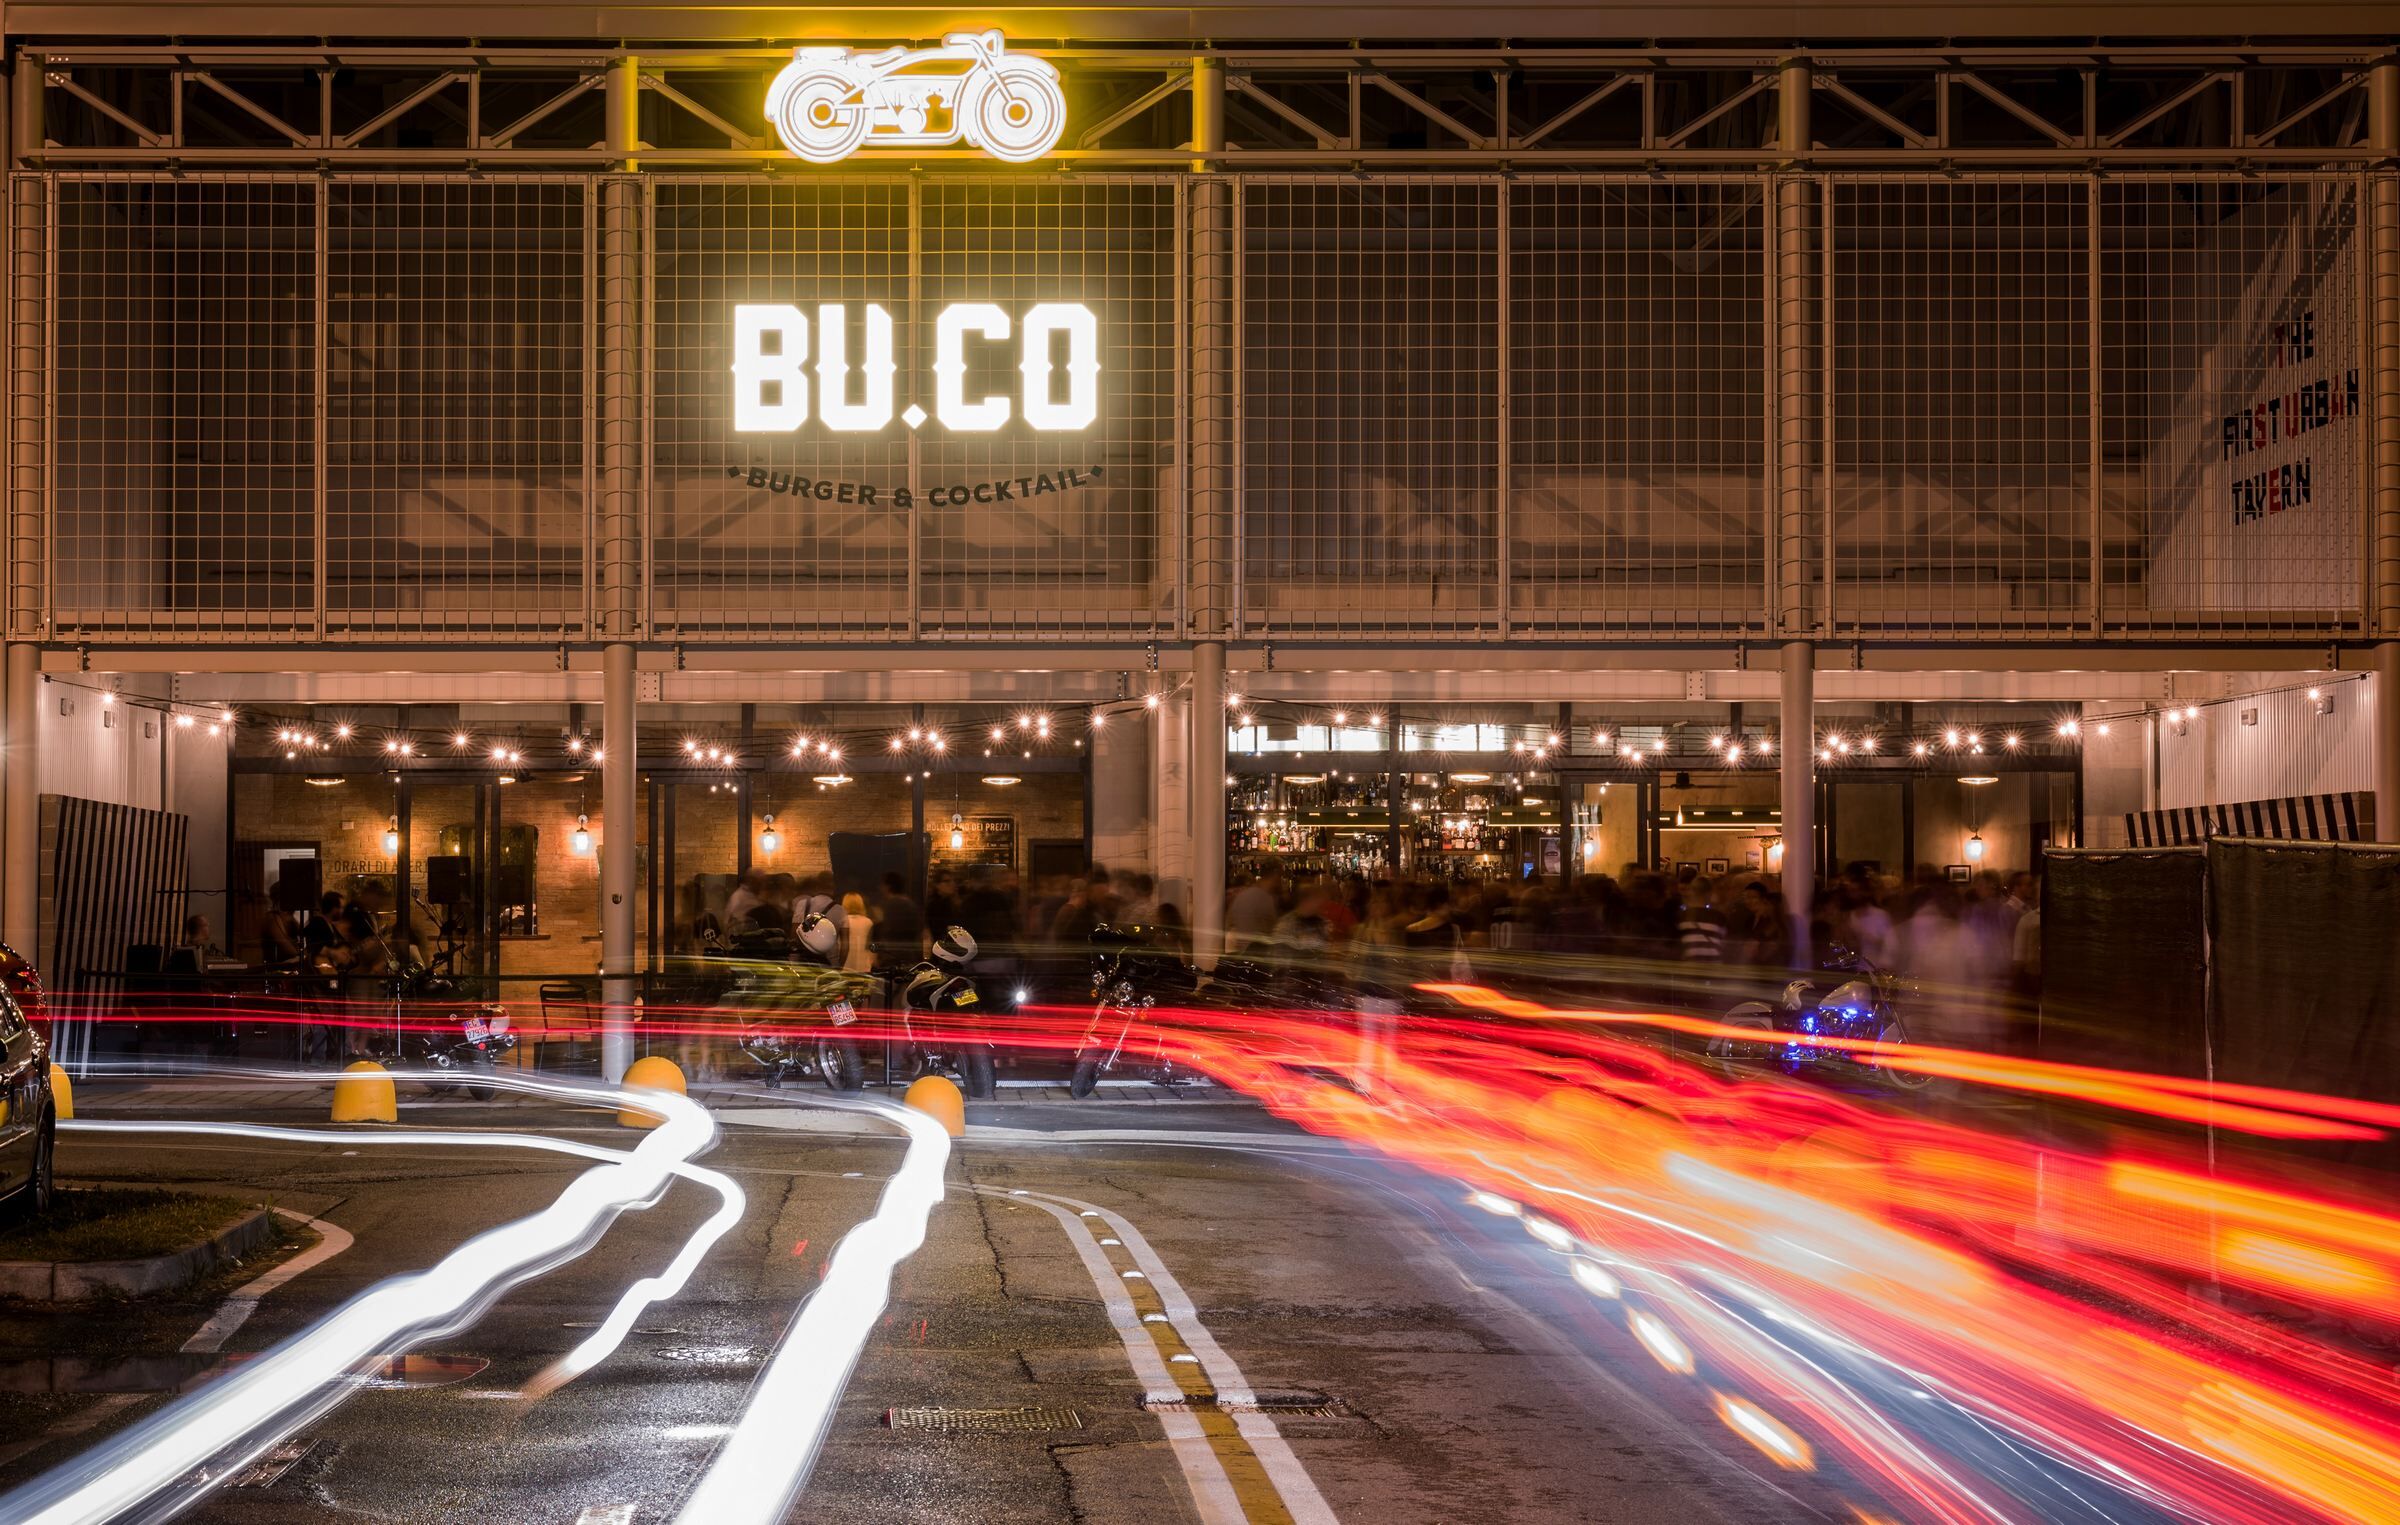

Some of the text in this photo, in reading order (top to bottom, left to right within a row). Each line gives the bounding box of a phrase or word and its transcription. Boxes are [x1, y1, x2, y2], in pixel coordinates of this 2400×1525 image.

[731, 303, 1101, 431] BU.CO
[2275, 311, 2314, 369] THE
[2223, 368, 2359, 461] FIRST URBAN
[746, 466, 1087, 509] BURGER & COCKTAIL
[2231, 457, 2311, 526] TAVERN
[985, 822, 1010, 832] PREZZI
